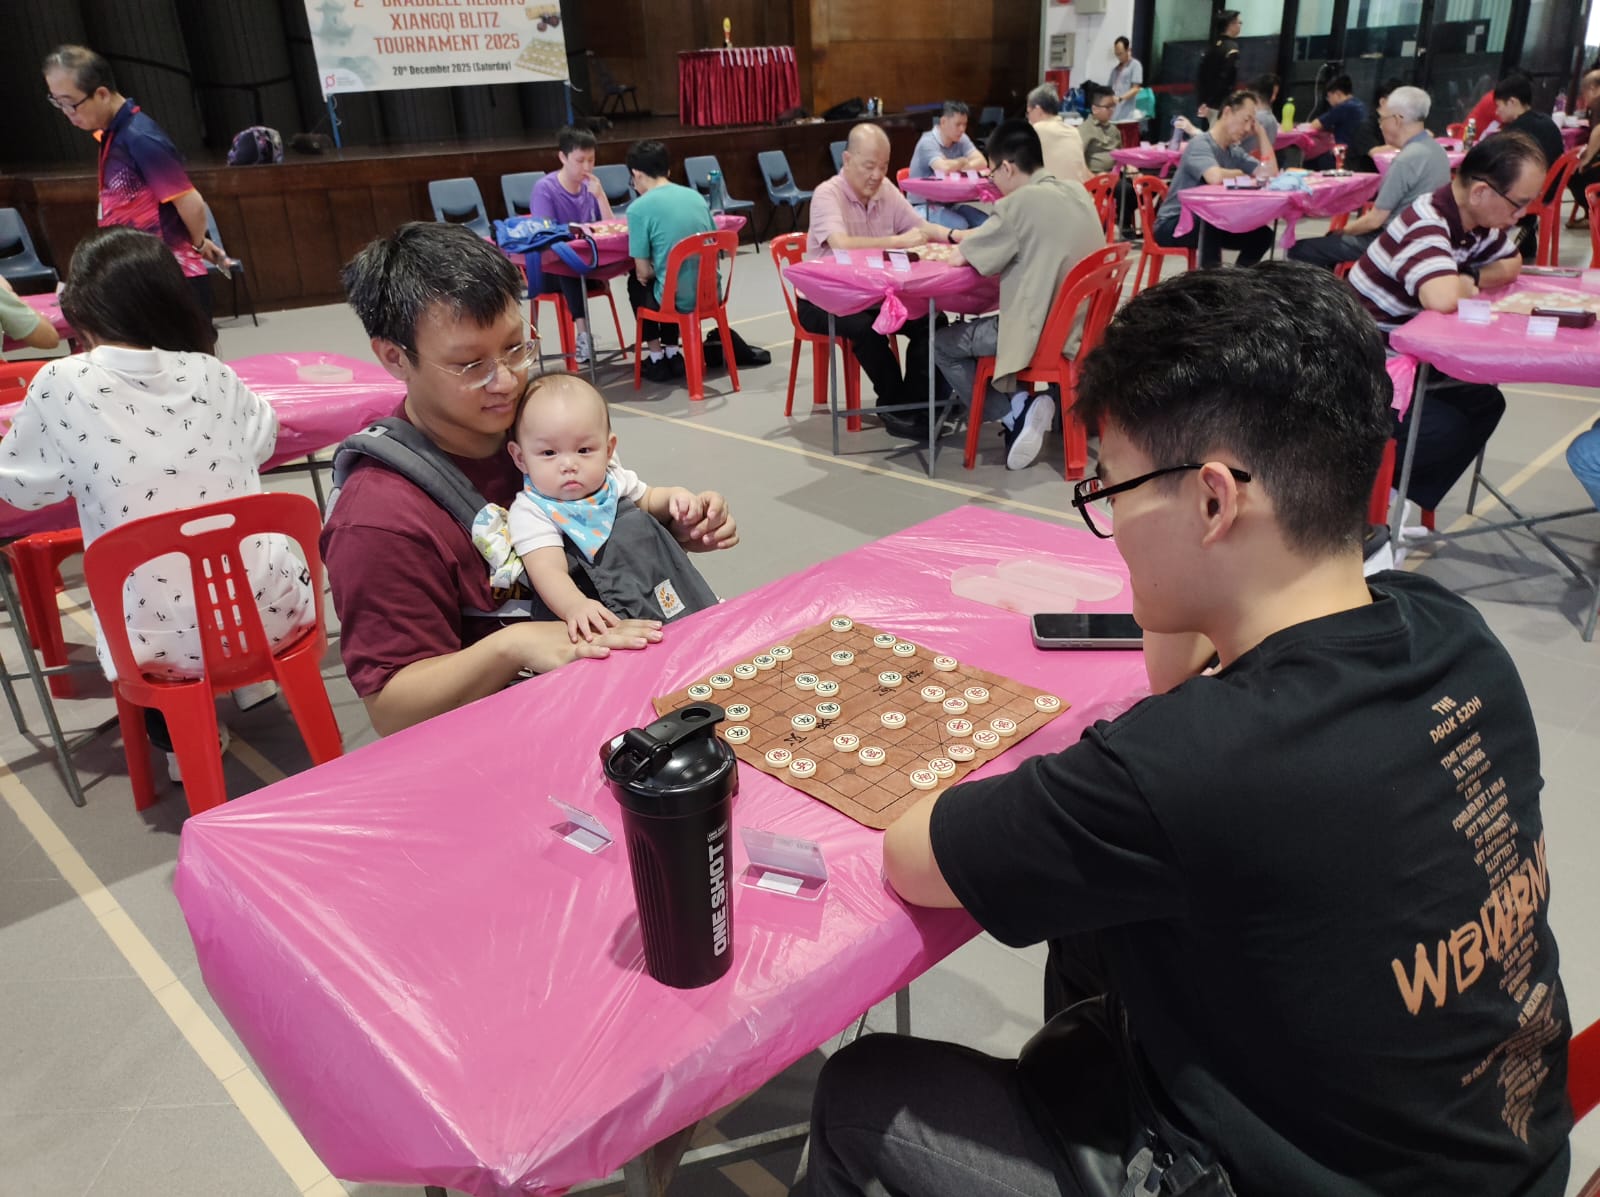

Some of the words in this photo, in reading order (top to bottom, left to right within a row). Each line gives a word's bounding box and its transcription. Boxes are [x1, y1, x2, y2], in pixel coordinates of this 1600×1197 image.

[390, 12, 455, 32] XIANGQI
[460, 11, 500, 29] BLITZ
[374, 35, 480, 55] TOURNAMENT
[484, 33, 520, 50] 2025
[409, 64, 450, 75] December
[452, 63, 472, 73] 2025
[473, 61, 512, 73] (Saturday)
[1432, 695, 1457, 715] THE
[708, 842, 726, 908] SHOT
[711, 909, 728, 957] ONE
